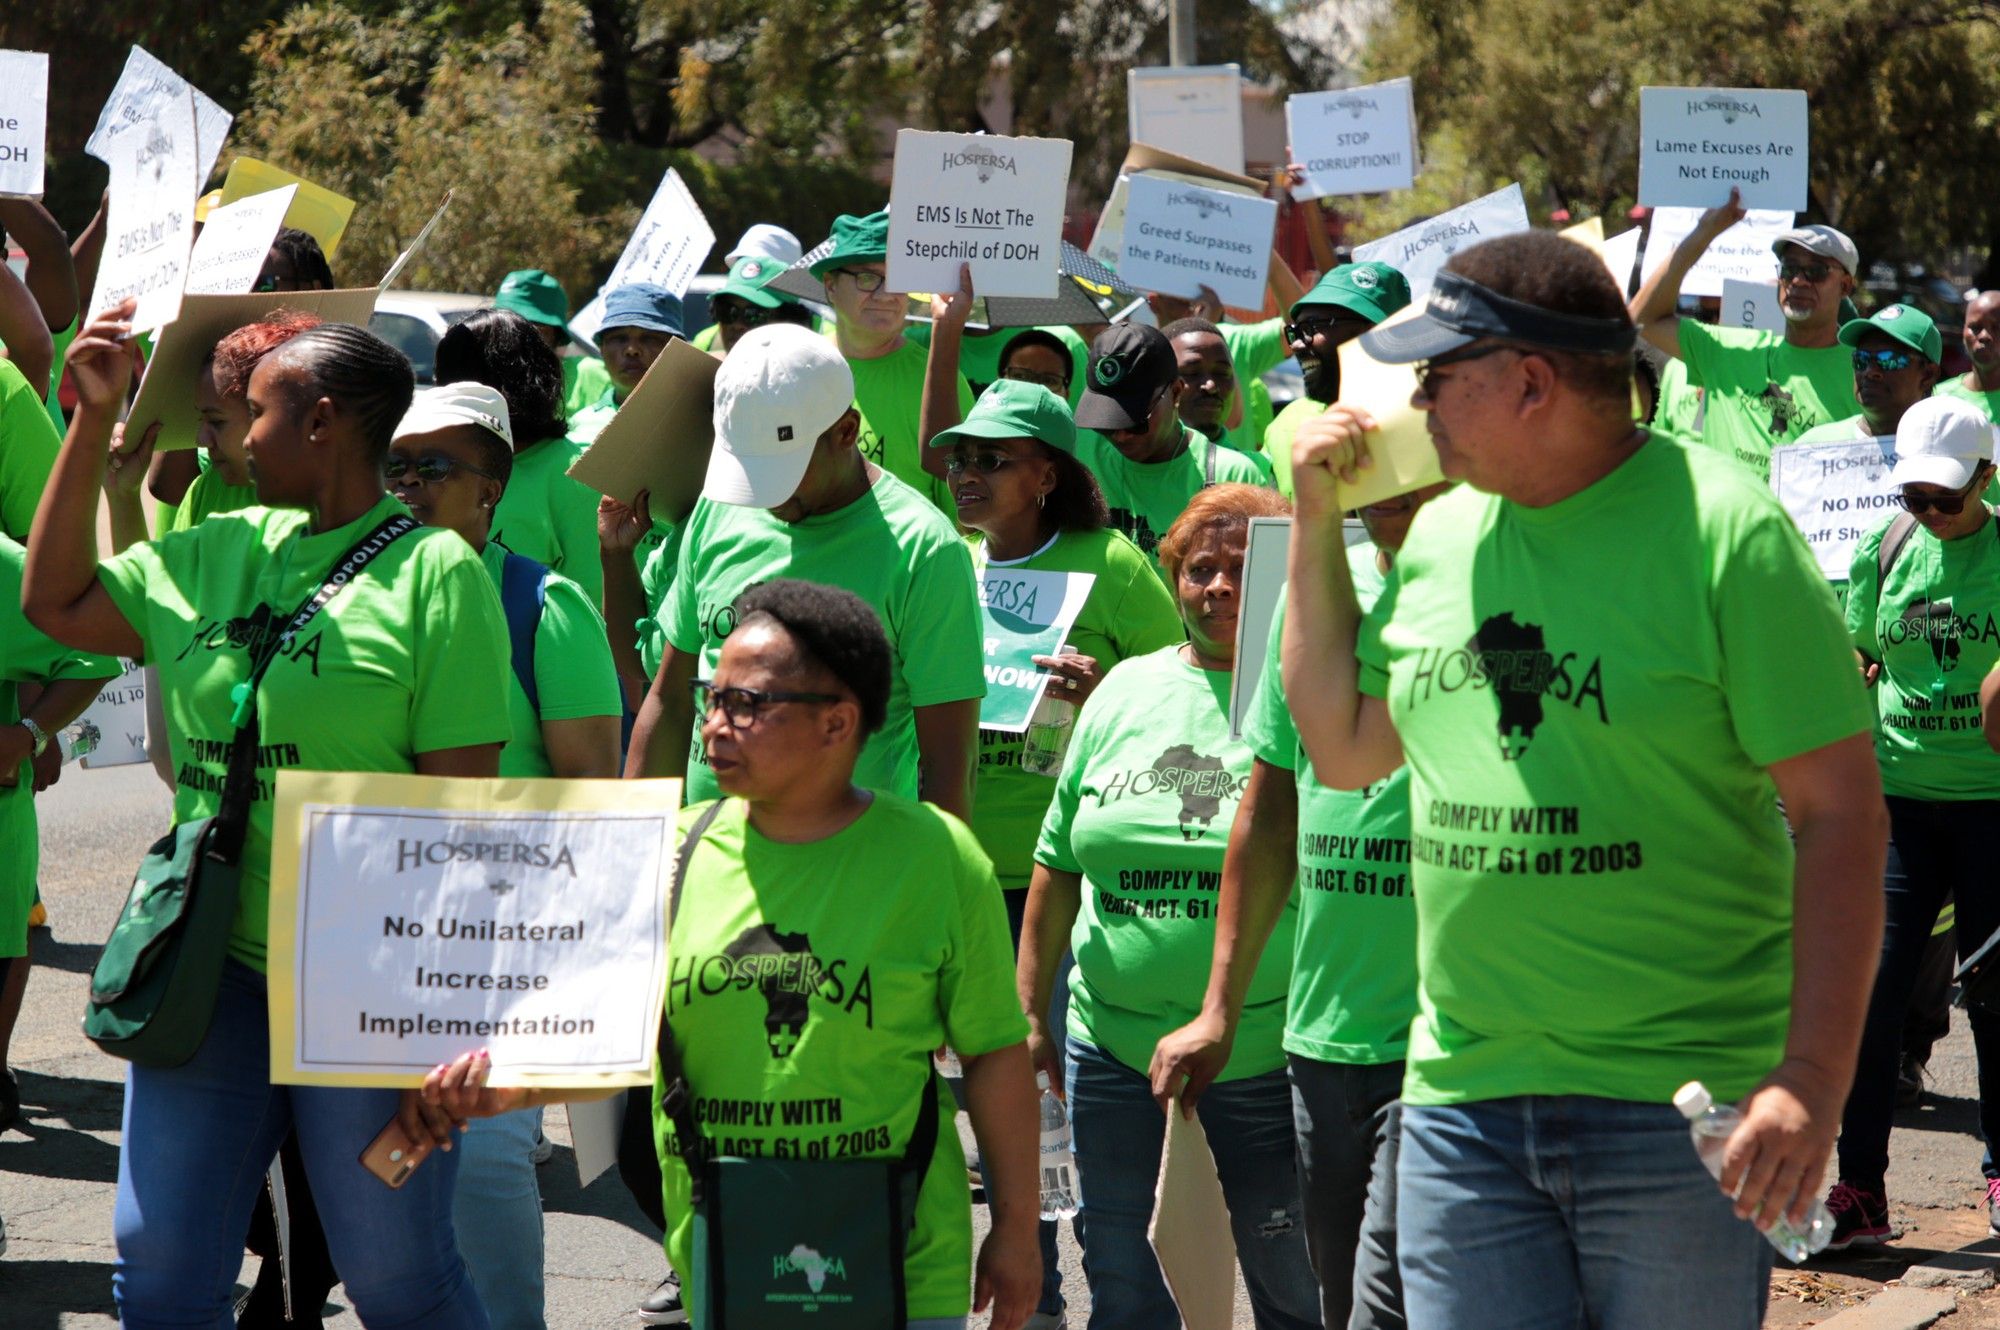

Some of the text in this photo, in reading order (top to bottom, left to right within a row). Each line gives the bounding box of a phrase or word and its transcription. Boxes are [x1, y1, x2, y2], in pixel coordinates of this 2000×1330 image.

[1687, 101, 1762, 118] HOSPERSA
[1337, 131, 1370, 147] STOP
[1655, 139, 1794, 156] Lame Excuses Are
[0, 145, 28, 163] OH
[942, 152, 1018, 176] HOSPERSA
[1307, 152, 1401, 172] CORRUPTION!!
[1679, 165, 1770, 183] Not Enough
[916, 205, 1034, 227] EMS Is Not The
[905, 239, 1040, 261] Stepchild of DOH
[1139, 221, 1254, 255] Greed Surpasses
[1403, 219, 1480, 261] HOSPERSA
[1741, 243, 1764, 256] the
[1128, 244, 1151, 261] the
[1154, 249, 1212, 272] Patients
[1214, 261, 1258, 280] Needs
[1822, 452, 1897, 477] HOSPERS
[1822, 494, 1900, 513] NO MOR
[1837, 526, 1866, 542] Sh
[294, 515, 413, 632] METROPOLITAN
[977, 579, 1039, 622] ERSA
[129, 689, 144, 702] ot
[1408, 646, 1611, 726] HOSPERSA
[1952, 692, 1980, 710] WIT
[1919, 715, 1946, 731] ACT.
[1951, 716, 1968, 732] 61
[1097, 766, 1251, 808] HOSPERS
[1429, 799, 1579, 835] COMPLY WITH
[396, 837, 578, 878] HOSPERSA
[1304, 832, 1360, 860] COMPLY
[1449, 843, 1492, 874] ACT.
[1499, 846, 1528, 874] 61
[1535, 847, 1564, 875] of
[1570, 840, 1643, 875] 2003
[1119, 869, 1223, 891] COMPLY WI
[1315, 868, 1349, 893] ACT.
[1353, 870, 1378, 896] 61
[1382, 873, 1406, 898] of
[1141, 898, 1181, 919] ACT.
[1186, 898, 1210, 919] 61
[383, 916, 585, 941] No Unilateral
[415, 967, 549, 991] Increase
[668, 953, 873, 1031] HOSPERSA
[359, 1011, 596, 1038] Implementation
[694, 1097, 842, 1127] COMPLY WITH
[773, 1137, 800, 1160] 61
[807, 1135, 830, 1160] of
[835, 1125, 891, 1159] 2003
